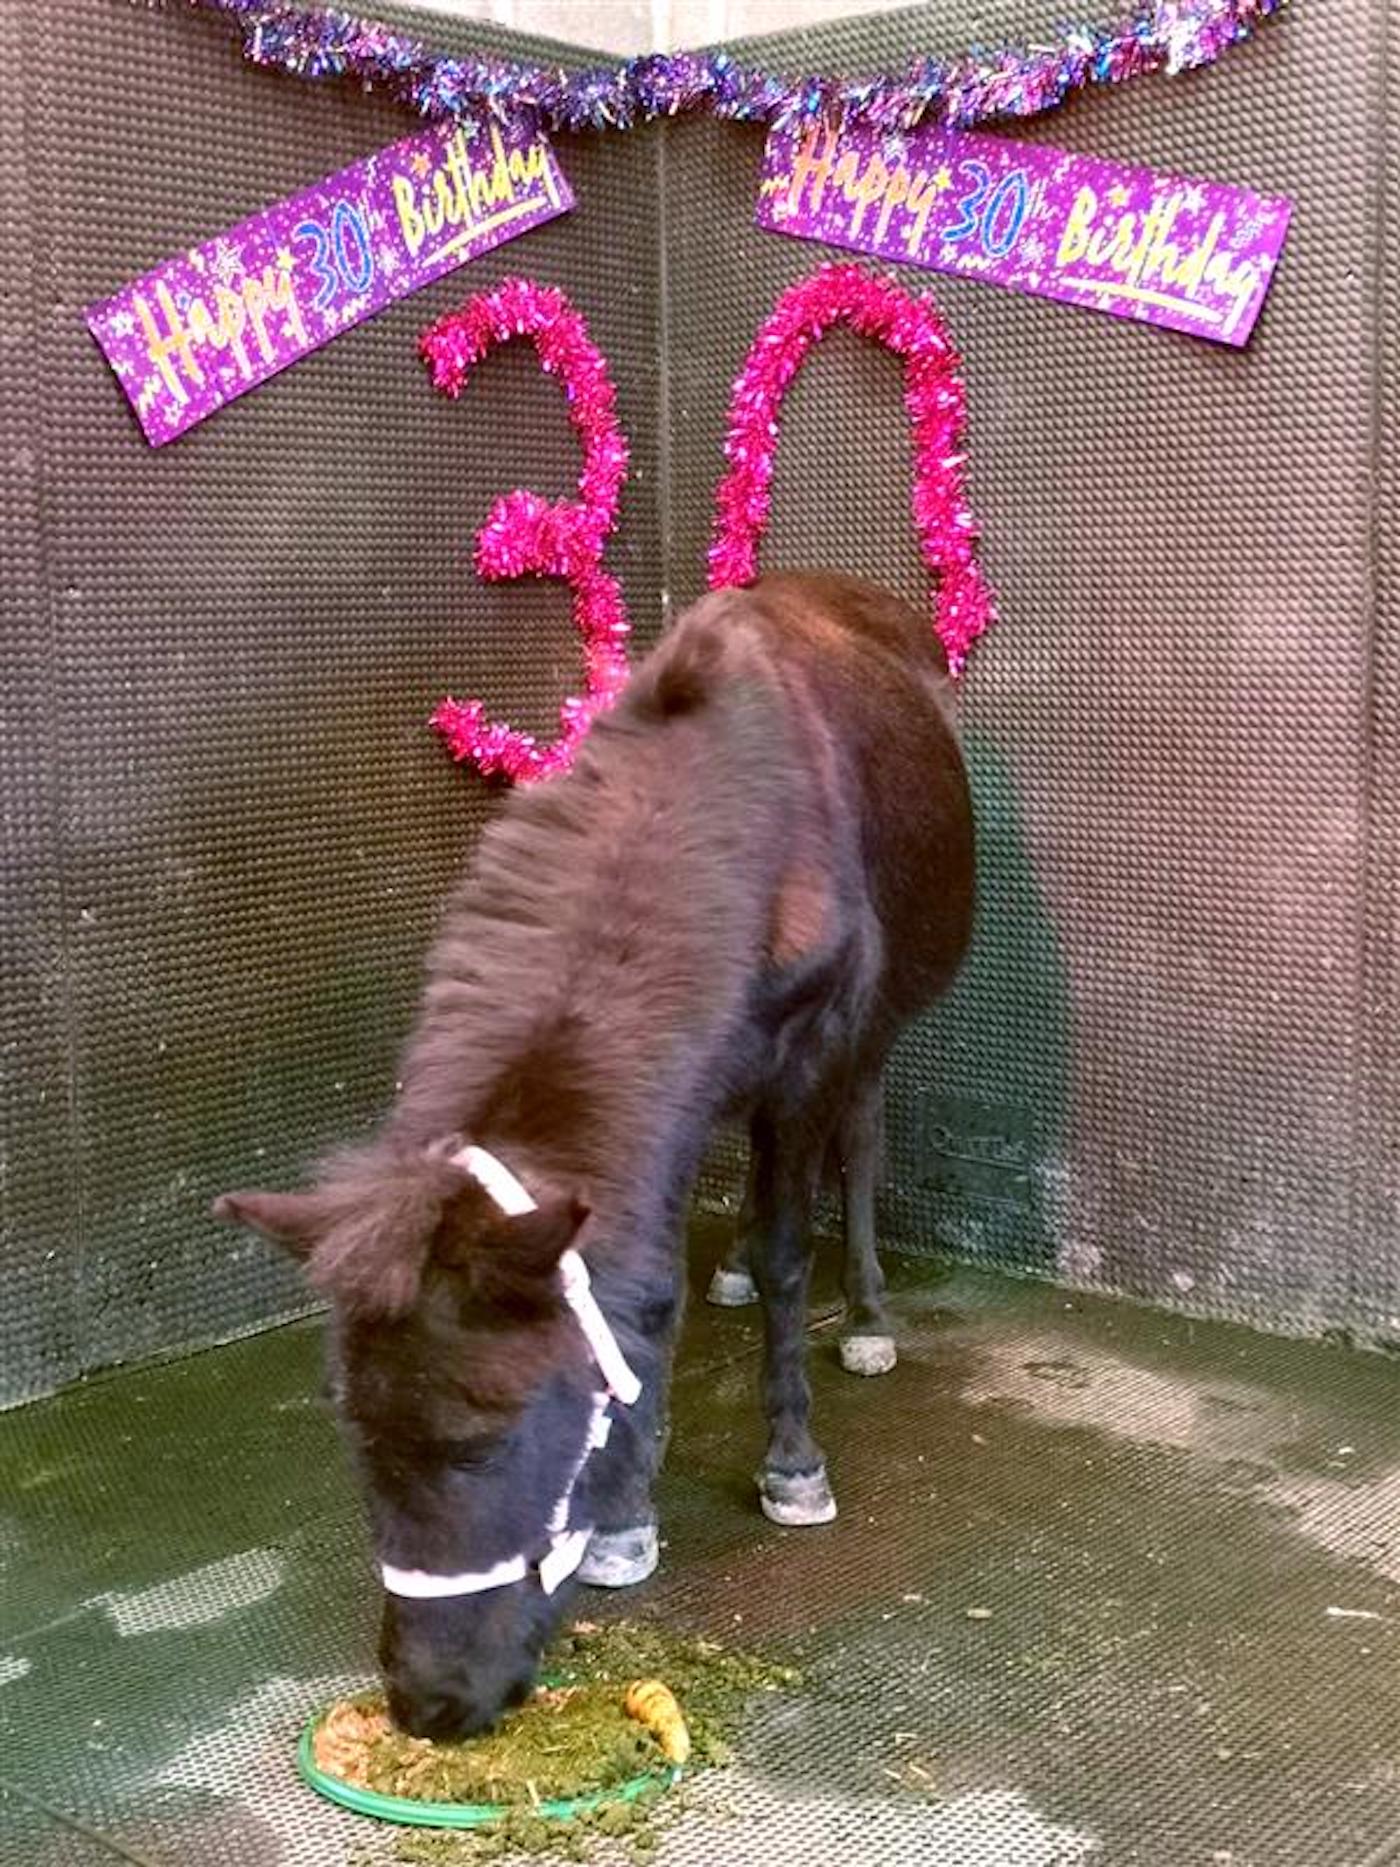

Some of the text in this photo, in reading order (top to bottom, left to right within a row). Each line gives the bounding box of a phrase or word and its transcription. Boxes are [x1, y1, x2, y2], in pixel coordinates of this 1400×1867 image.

[131, 266, 309, 404] Happy
[391, 121, 562, 257] Birthday
[786, 117, 938, 256] Happy
[1055, 184, 1262, 337] Birthday
